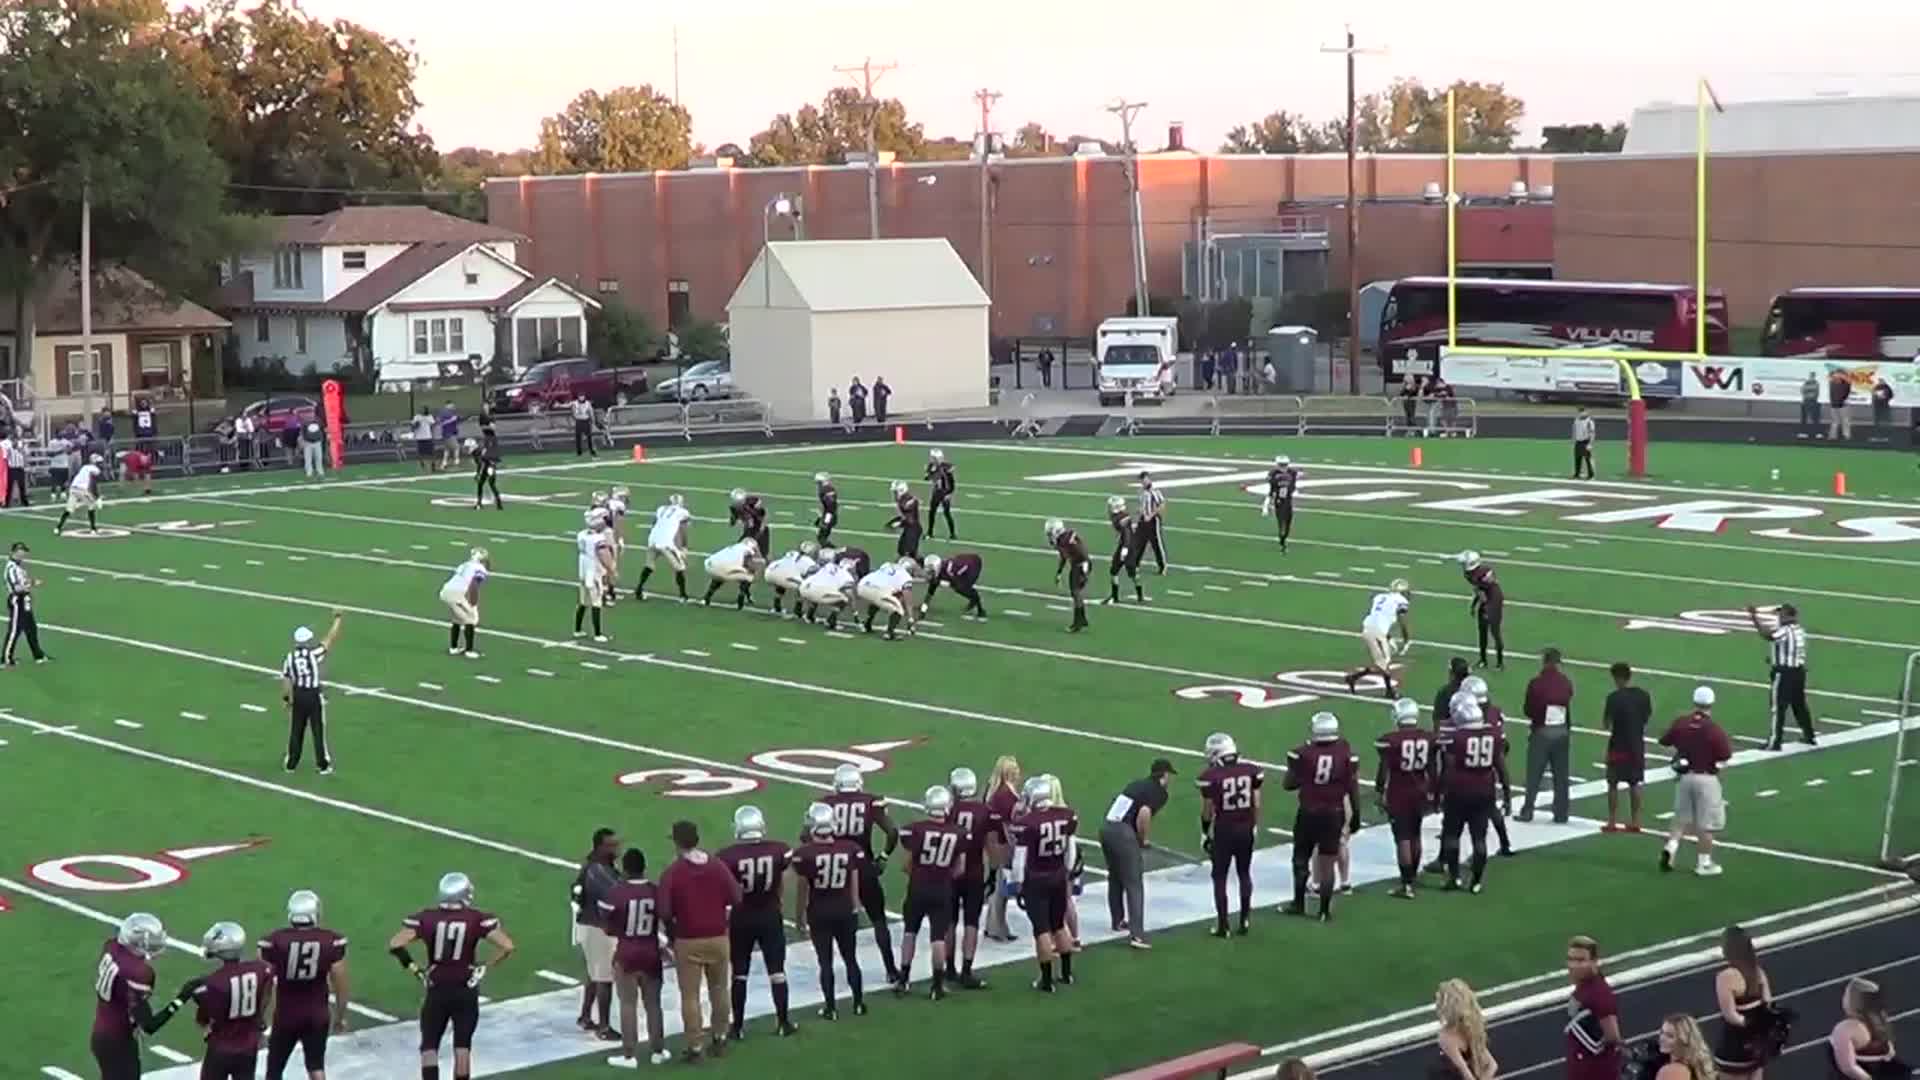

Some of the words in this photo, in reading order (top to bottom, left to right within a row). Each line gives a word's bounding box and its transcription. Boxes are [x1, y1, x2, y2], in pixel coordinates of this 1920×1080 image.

[1565, 327, 1655, 344] VILLAGE
[1314, 754, 1333, 785] 8
[1401, 738, 1429, 771] 93
[1464, 735, 1495, 768] 99
[1222, 775, 1252, 811] 23
[920, 830, 958, 867] 50
[1038, 819, 1068, 857] 25
[738, 855, 774, 894] 37
[814, 852, 849, 889] 36
[625, 898, 656, 937] 16
[434, 920, 467, 961] 17
[286, 941, 321, 980] 13
[229, 971, 258, 1019] 18
